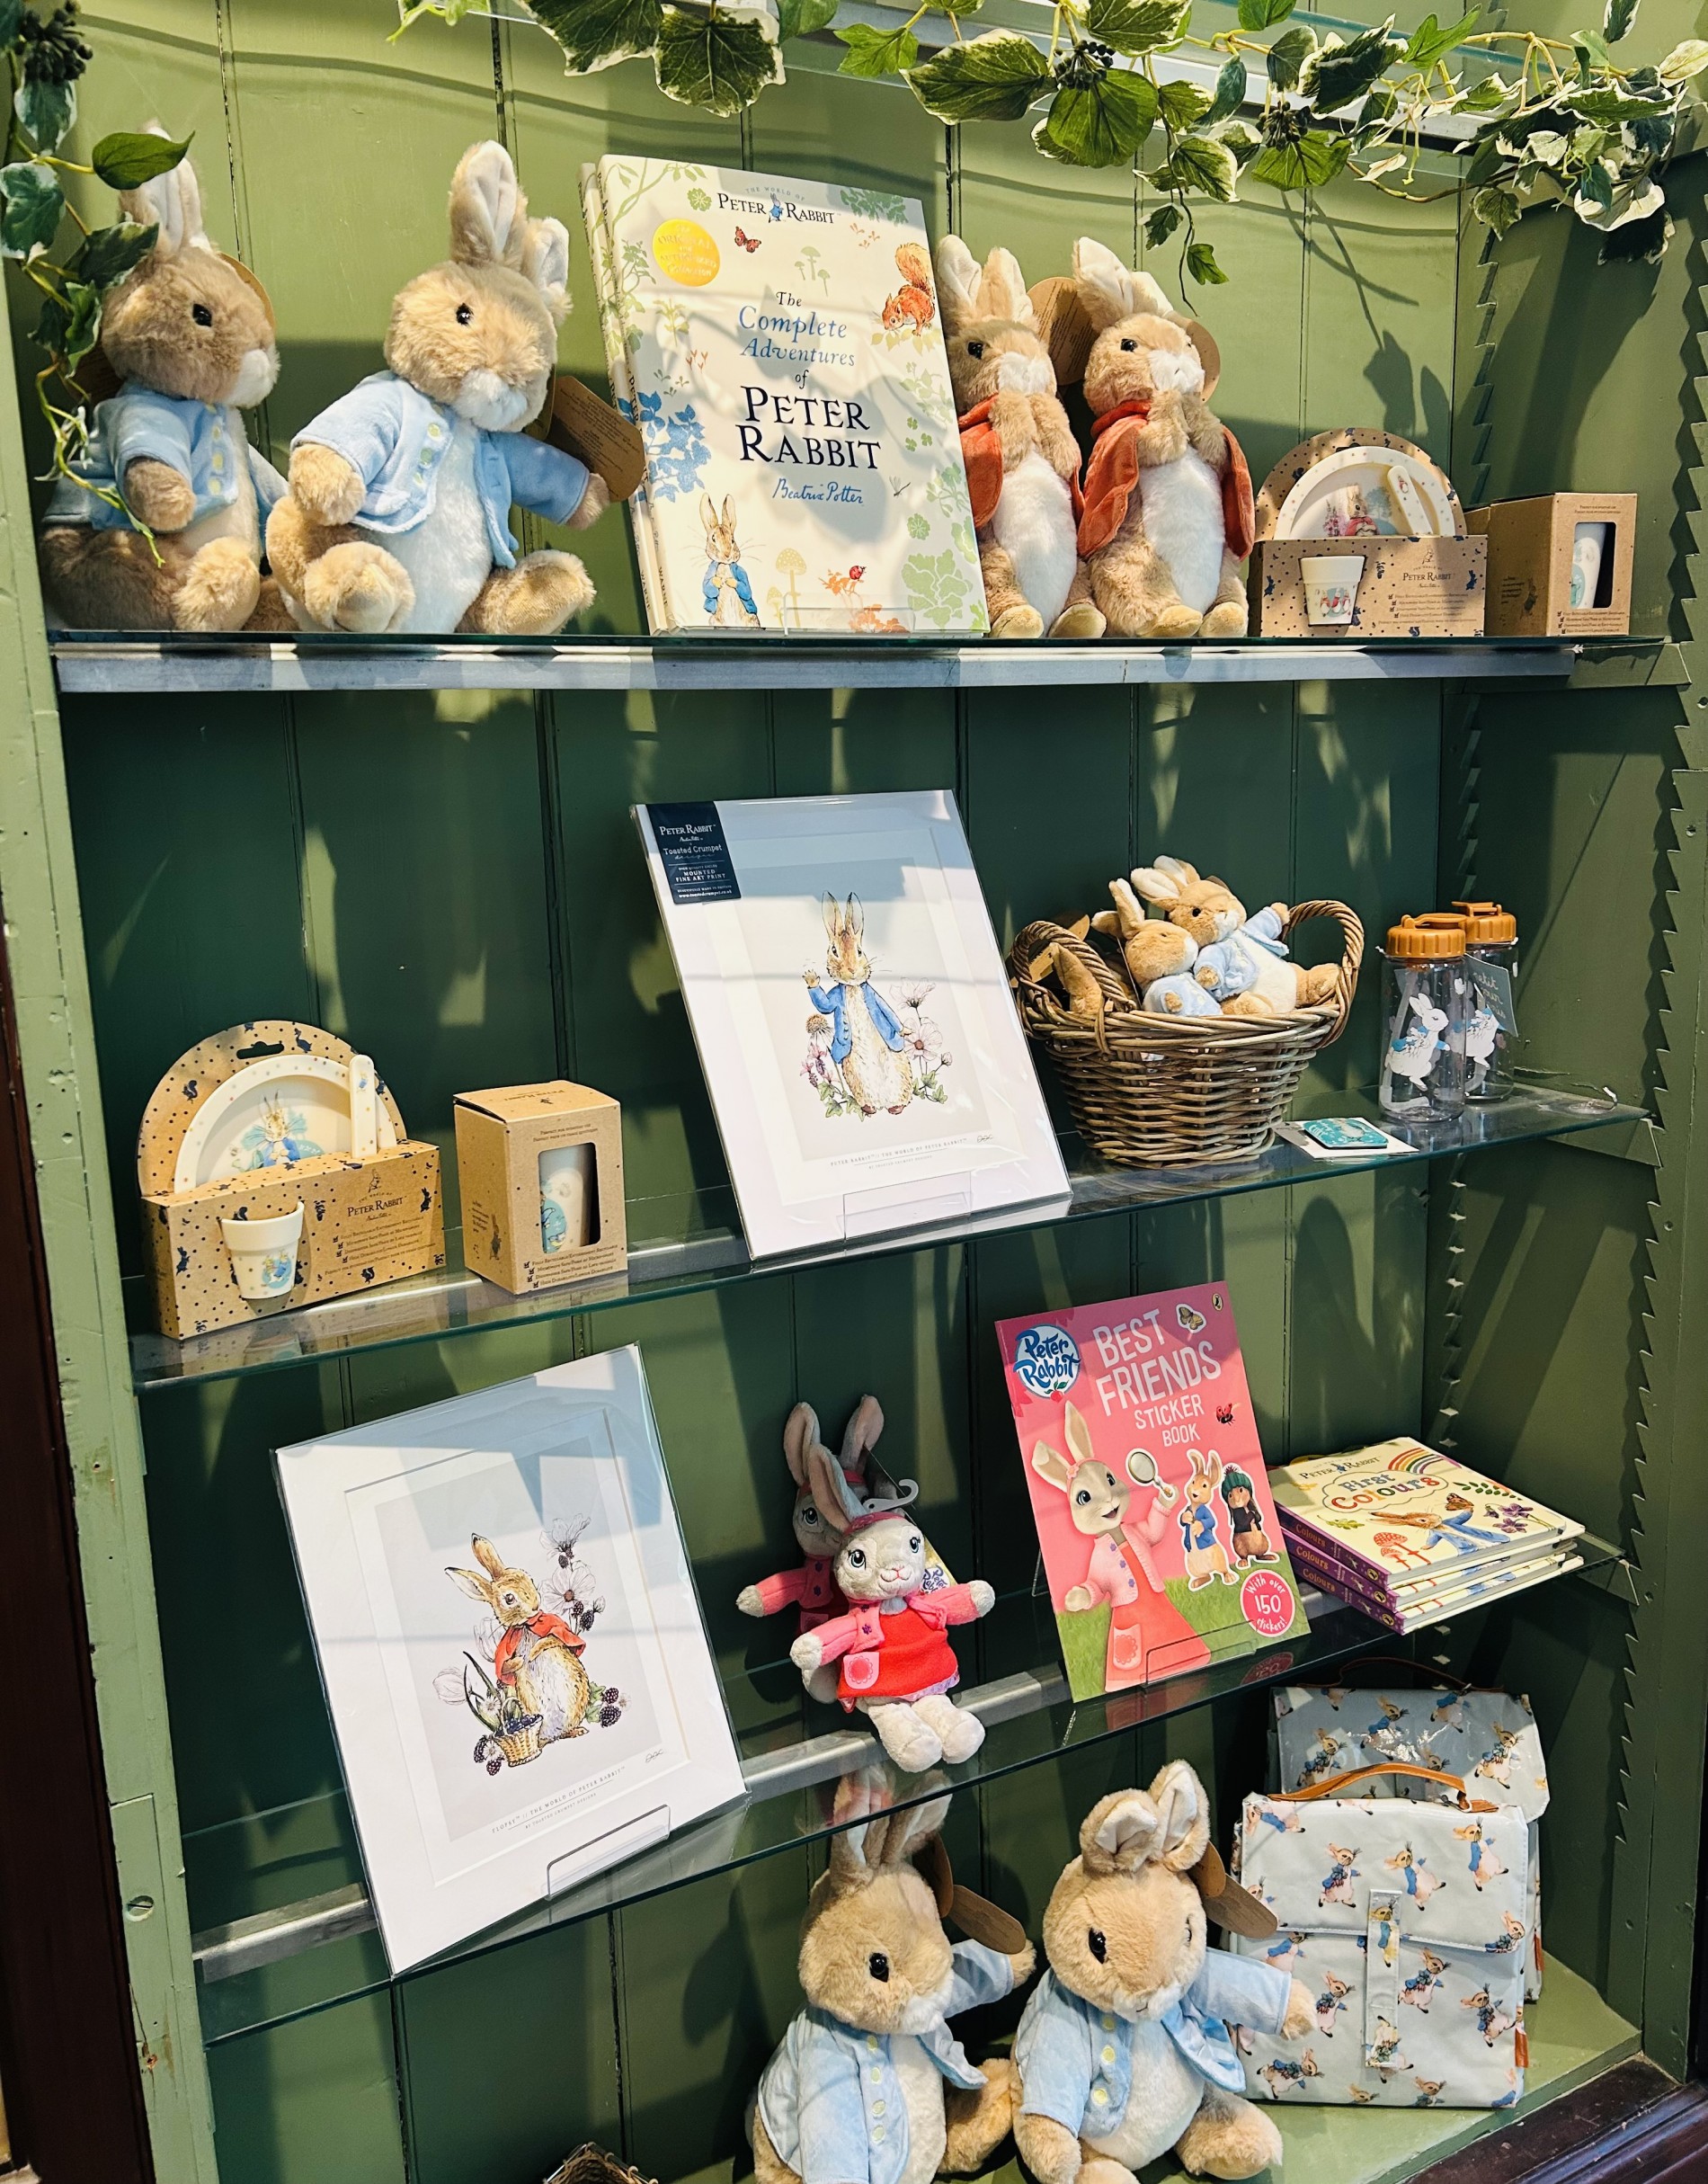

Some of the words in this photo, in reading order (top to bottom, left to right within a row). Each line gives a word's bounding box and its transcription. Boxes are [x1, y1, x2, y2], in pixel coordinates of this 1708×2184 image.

[745, 186, 761, 194] THE
[764, 186, 791, 196] WORLD
[796, 193, 805, 202] OF
[717, 192, 767, 215] PETER
[785, 201, 835, 224] RABBIT
[776, 290, 803, 308] The
[738, 304, 848, 341] Complete
[739, 338, 856, 367] Adventures
[795, 369, 810, 389] of
[740, 385, 871, 432] PETER
[735, 423, 881, 470] RABBIT
[771, 477, 825, 502] Beatrix
[825, 480, 865, 504] Potter
[1402, 572, 1426, 582] PETER
[1427, 571, 1452, 582] RABBIT
[659, 825, 686, 836] PETER
[685, 824, 714, 835] RABBIT
[663, 846, 692, 856] Toasted
[693, 843, 723, 853] Crumpet
[683, 869, 716, 877] MOUNTED
[347, 1204, 375, 1217] PETER
[375, 1197, 404, 1211] RABBIT
[1016, 1329, 1069, 1362] Peter
[1092, 1308, 1166, 1368] BEST
[1013, 1353, 1081, 1388] Rabbit
[1095, 1341, 1222, 1417] FRIENDS
[1134, 1393, 1205, 1430] STICKER
[1161, 1423, 1201, 1447] BOOK
[1299, 1466, 1335, 1480] PETER
[1345, 1457, 1381, 1471] RABBIT
[1331, 1476, 1440, 1510] Colours
[1338, 1474, 1395, 1493] First
[1295, 1523, 1327, 1547] Colours
[1295, 1546, 1329, 1570] Colours
[932, 1564, 947, 1589] Pete
[1245, 1573, 1267, 1593] With
[1268, 1579, 1285, 1593] over
[1303, 1568, 1336, 1592] Colours
[1254, 1594, 1281, 1615] 150
[530, 1805, 542, 1815] THE
[545, 1795, 566, 1808] WORLD
[578, 1780, 598, 1793] PETER
